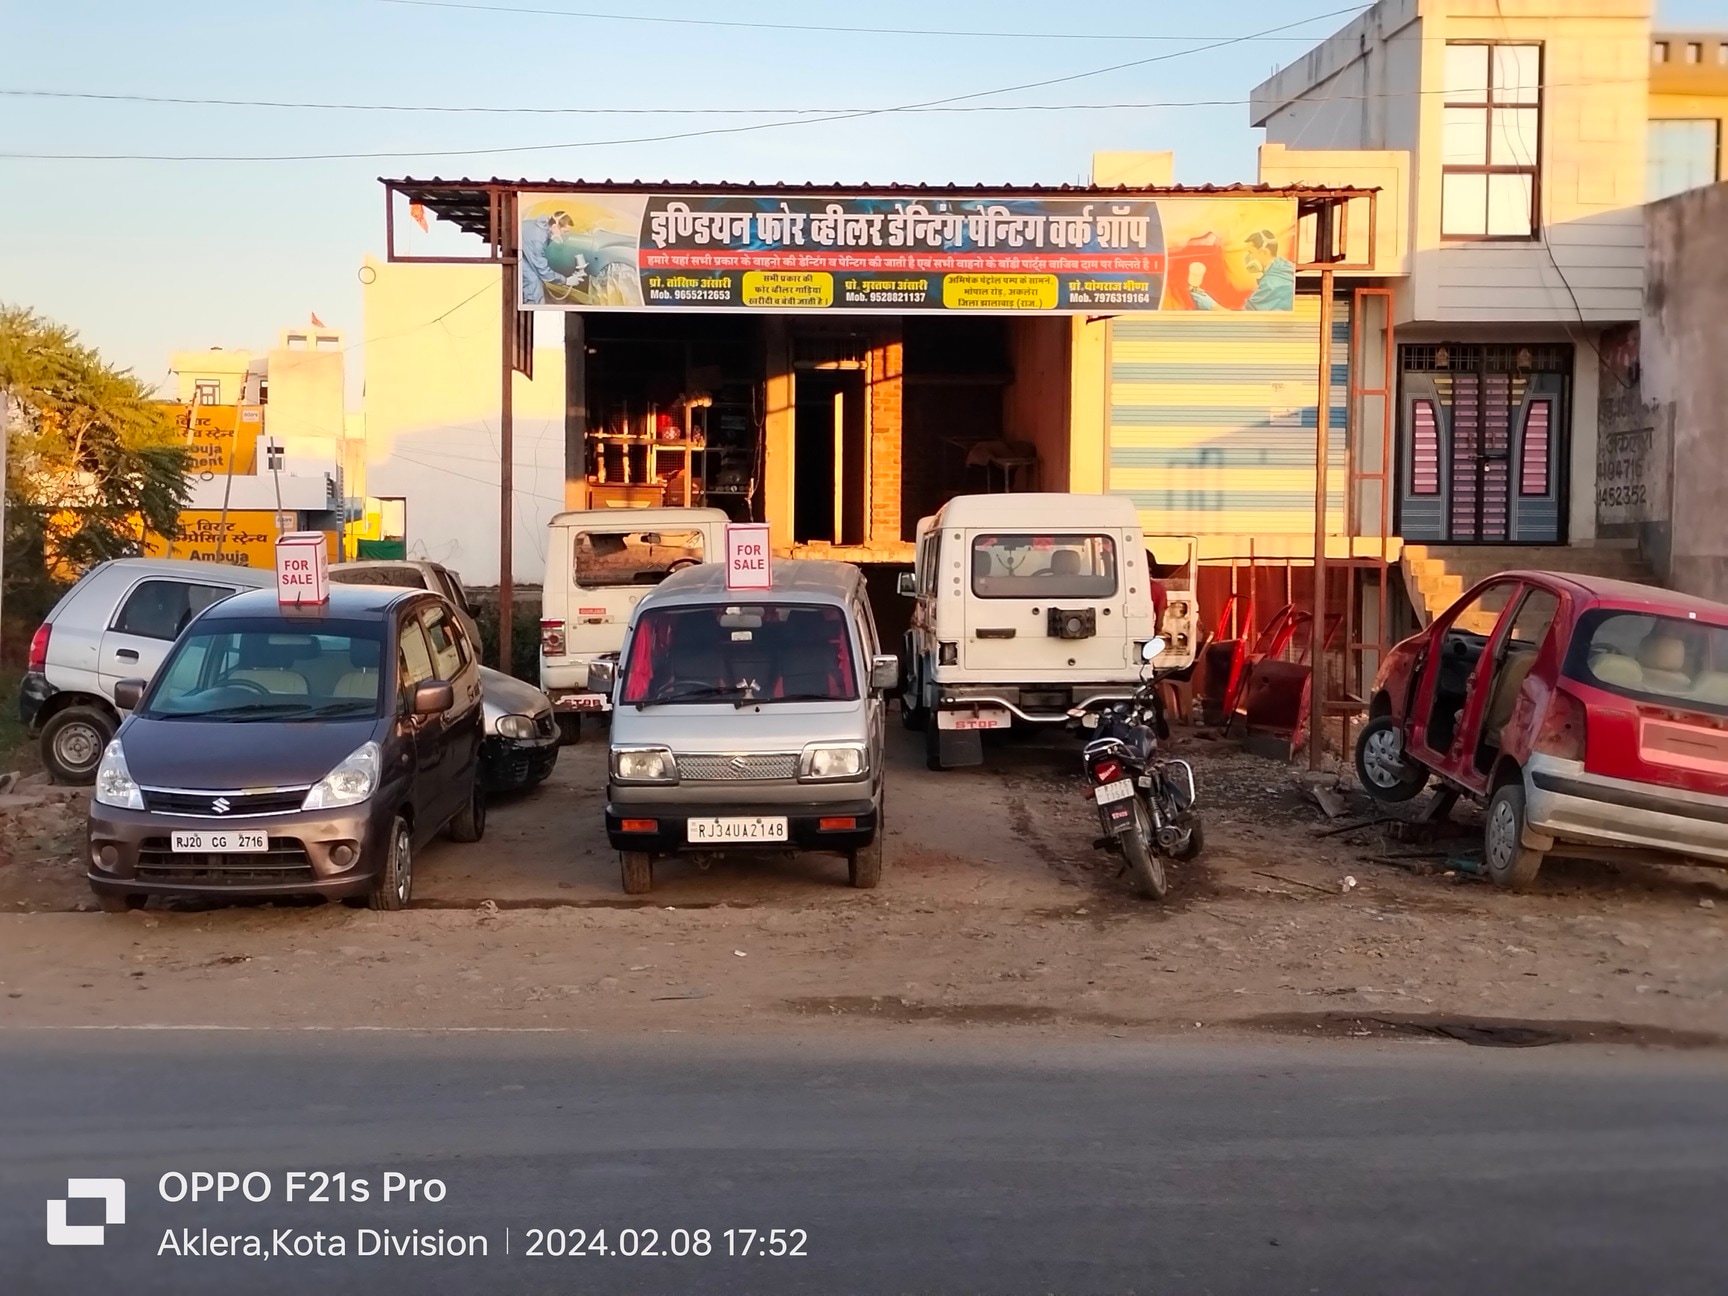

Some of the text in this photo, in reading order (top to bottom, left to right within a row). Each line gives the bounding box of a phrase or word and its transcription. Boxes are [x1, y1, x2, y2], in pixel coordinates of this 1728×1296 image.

[650, 201, 1150, 249] इण्डियन फोर व्हीलर डेन्टिंग पेन्टिग वर्क शॉप
[647, 253, 669, 266] हमारे
[690, 253, 712, 265] सभी
[713, 256, 738, 266] प्रकार
[740, 254, 751, 266] के
[782, 254, 796, 266] की
[828, 258, 836, 267] व
[868, 256, 881, 267] की
[884, 256, 906, 267] जाती
[908, 255, 915, 269] है
[917, 256, 931, 270] एवं
[933, 256, 954, 268] सभी
[985, 256, 996, 268] के
[1081, 259, 1098, 270] दाम
[1100, 260, 1112, 270] पर
[1114, 257, 1140, 270] मिलते
[763, 273, 779, 282] सभी
[802, 274, 813, 282] की
[650, 289, 731, 300] Mob. 9655212653
[964, 287, 988, 295] भोपाल
[846, 292, 868, 302] Mob.
[1069, 293, 1150, 303] Mob. 7976319164
[958, 298, 978, 307] जिला
[737, 545, 761, 555] FOR
[284, 560, 309, 570] FOR
[734, 559, 765, 570] SALE
[282, 574, 313, 585] SALE
[955, 720, 997, 728] STOP
[699, 823, 783, 838] RJ34UA2148
[176, 836, 263, 847] RJ20 CG 2716
